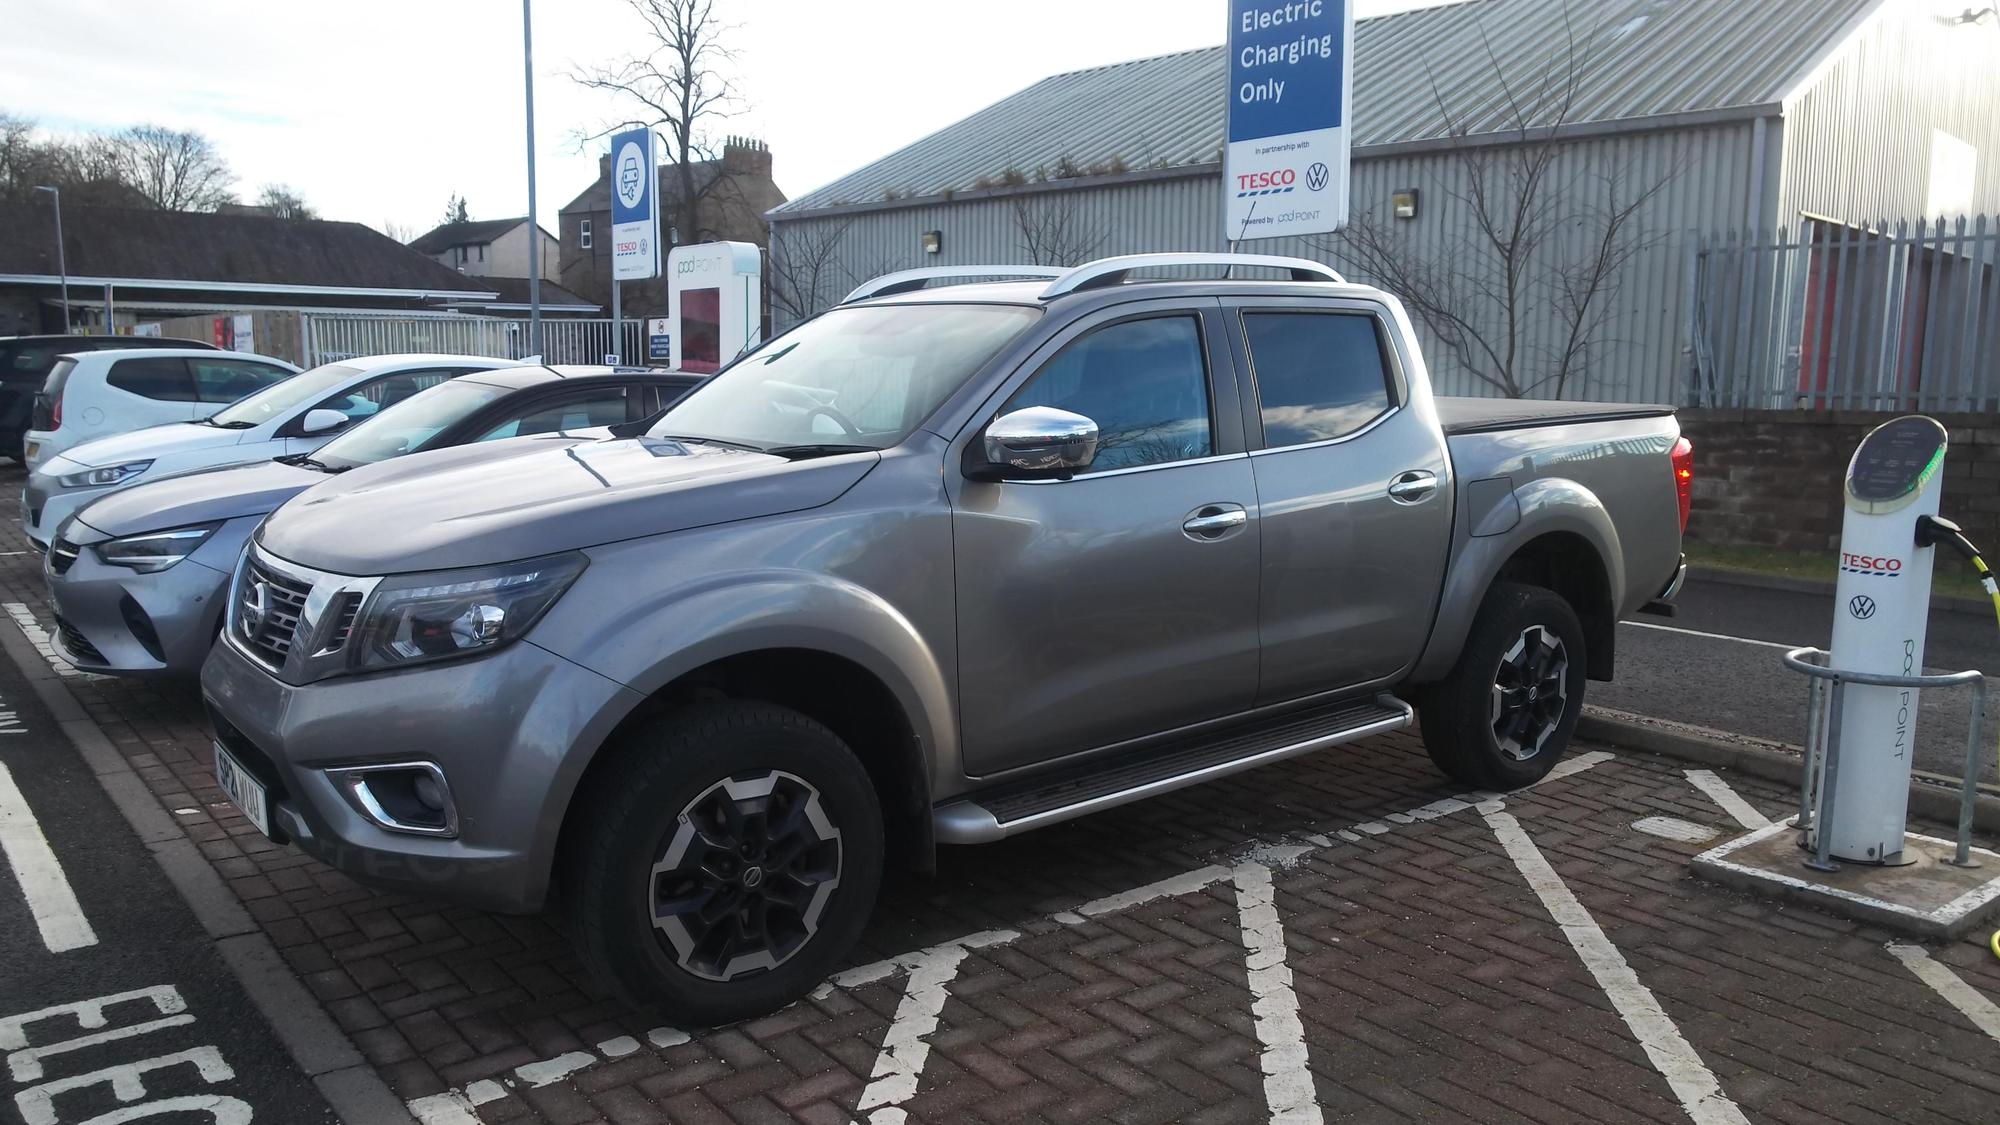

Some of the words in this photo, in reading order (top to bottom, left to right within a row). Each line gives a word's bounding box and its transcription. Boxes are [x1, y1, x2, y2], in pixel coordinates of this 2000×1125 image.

[1242, 0, 1322, 33] Electric
[1240, 34, 1332, 68] Charging
[1240, 77, 1285, 104] Only
[1255, 147, 1261, 155] In
[1261, 142, 1296, 155] partnership
[1296, 141, 1310, 149] with
[1237, 168, 1296, 190] TESCO
[1241, 216, 1266, 226] Powered
[1266, 215, 1274, 225] by
[616, 241, 637, 252] TESCO
[1842, 552, 1902, 571] TESCO
[1894, 691, 1910, 761] POINT
